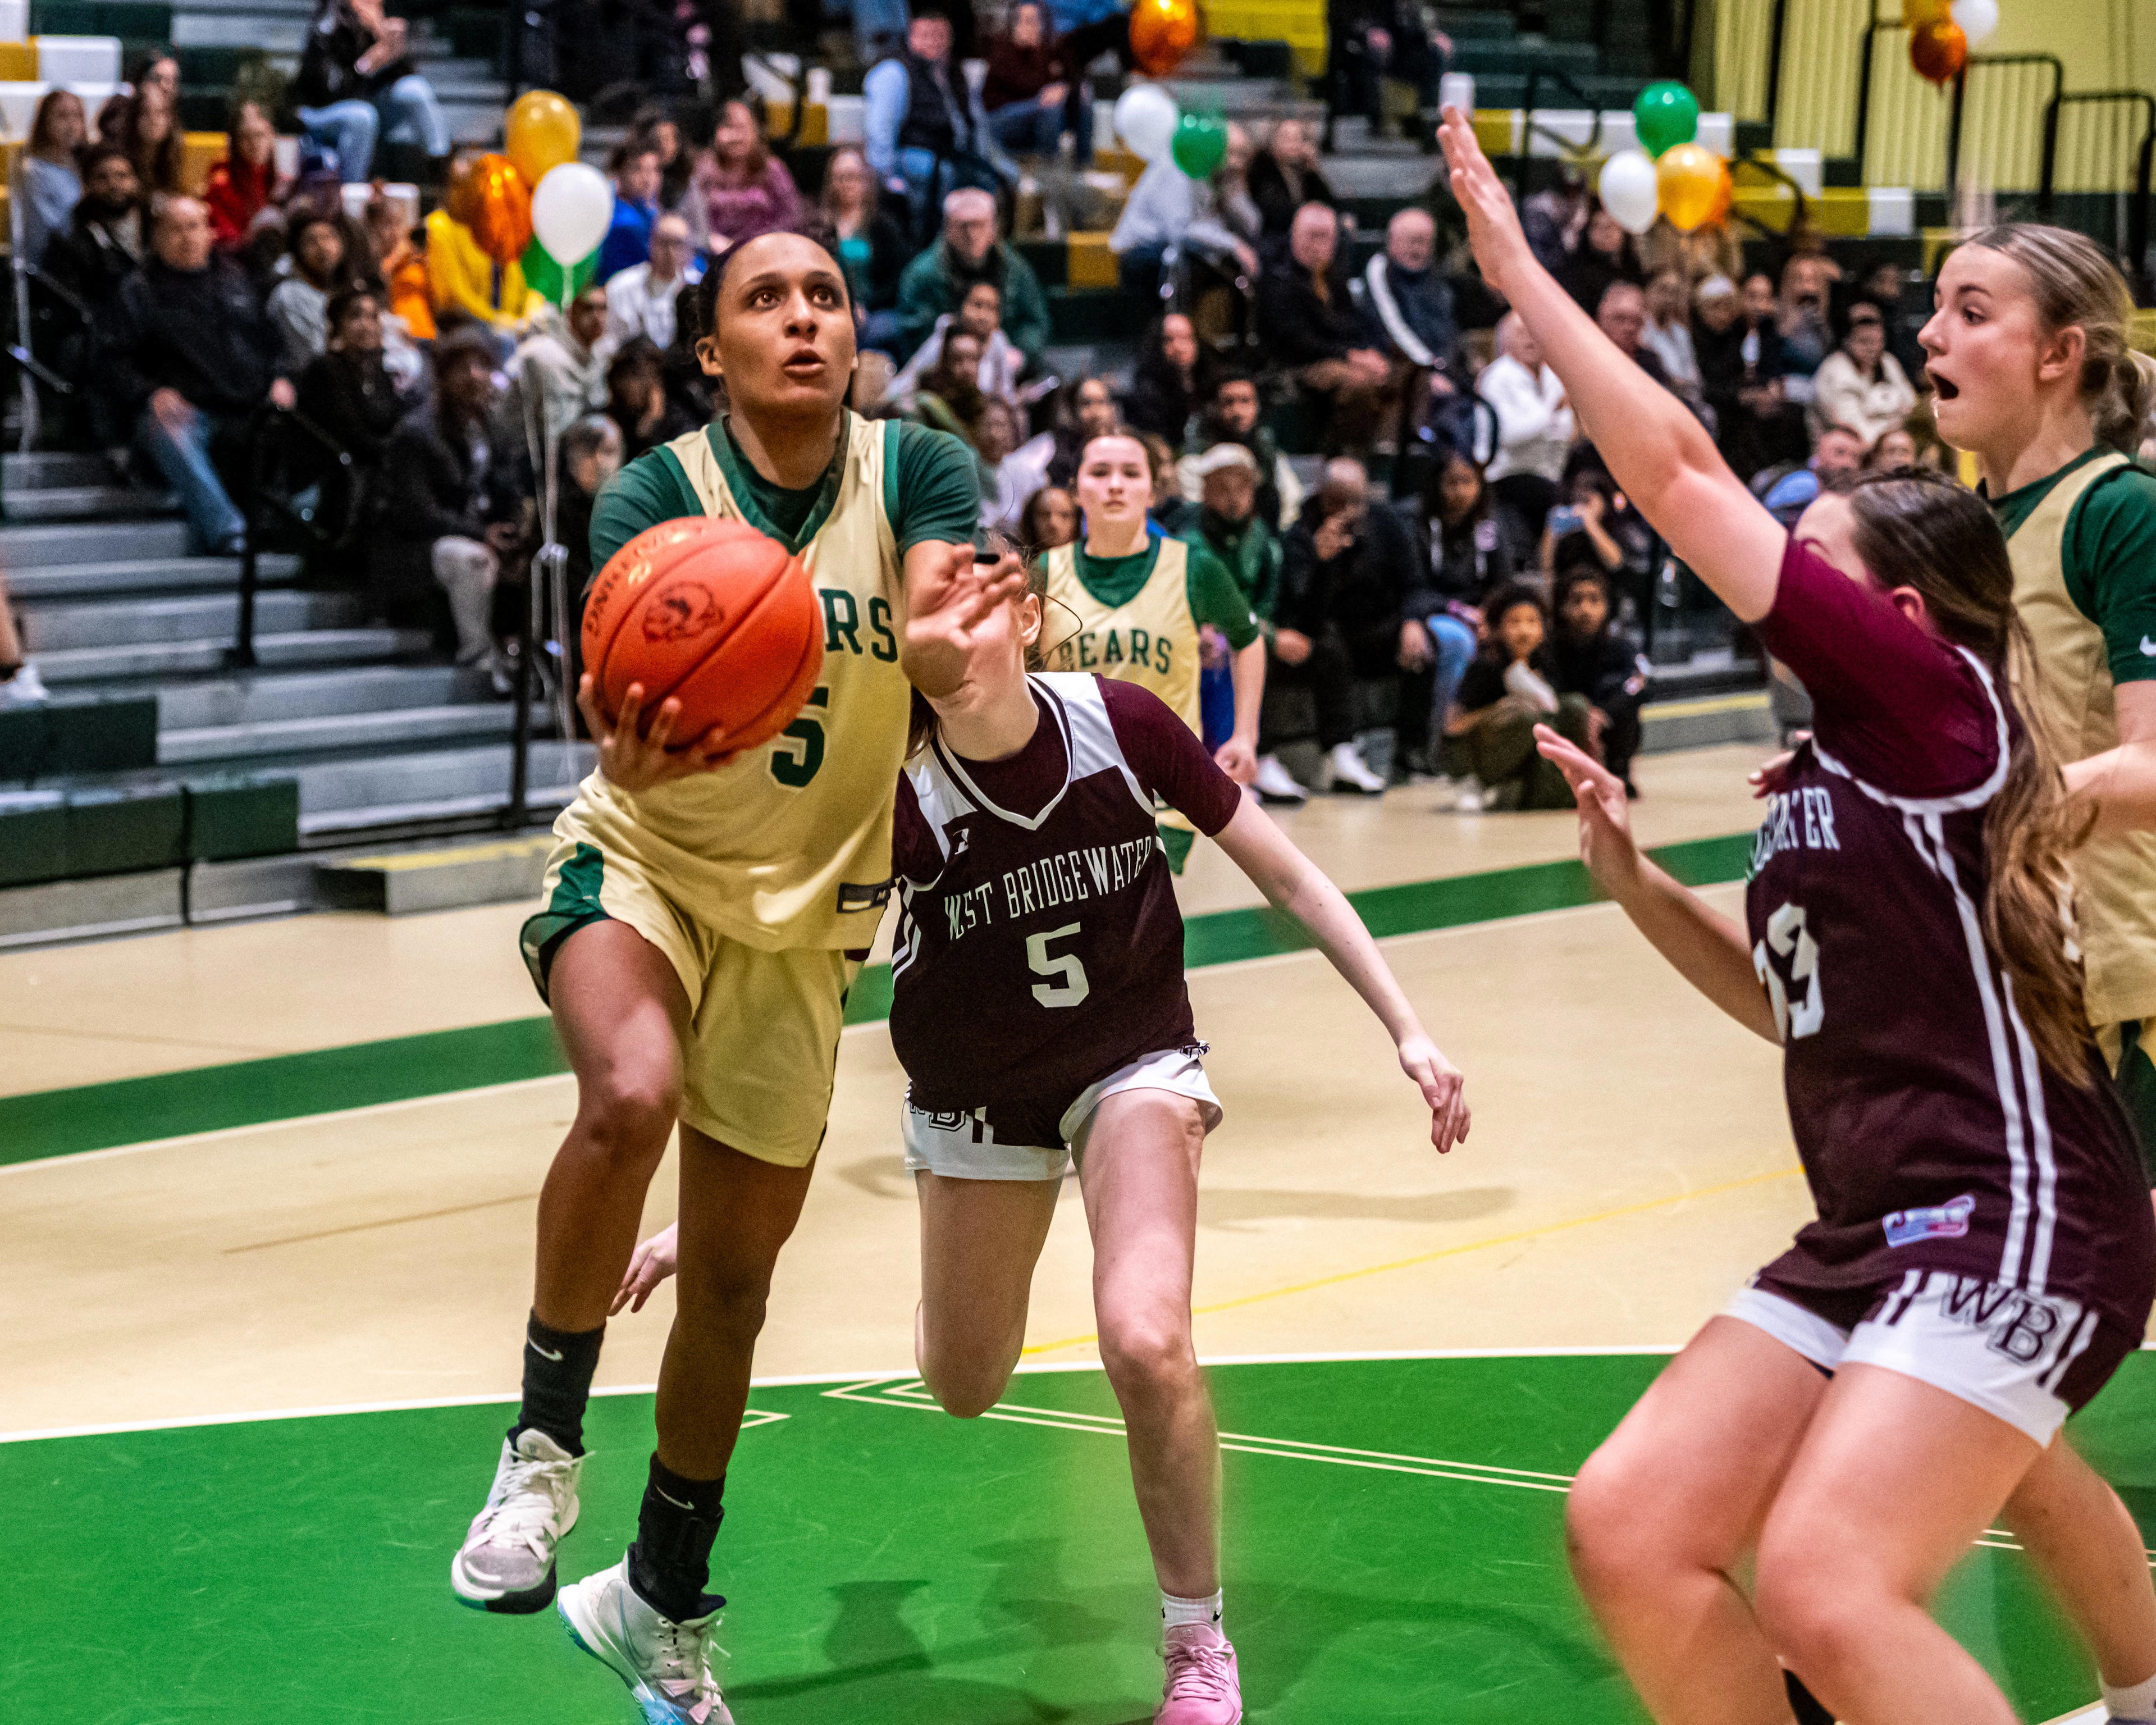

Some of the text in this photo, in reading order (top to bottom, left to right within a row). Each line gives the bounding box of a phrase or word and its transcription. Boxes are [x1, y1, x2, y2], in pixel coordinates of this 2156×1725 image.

[770, 686, 829, 787] 5
[1025, 921, 1090, 1008] 5
[1939, 1275, 2062, 1365] WB
